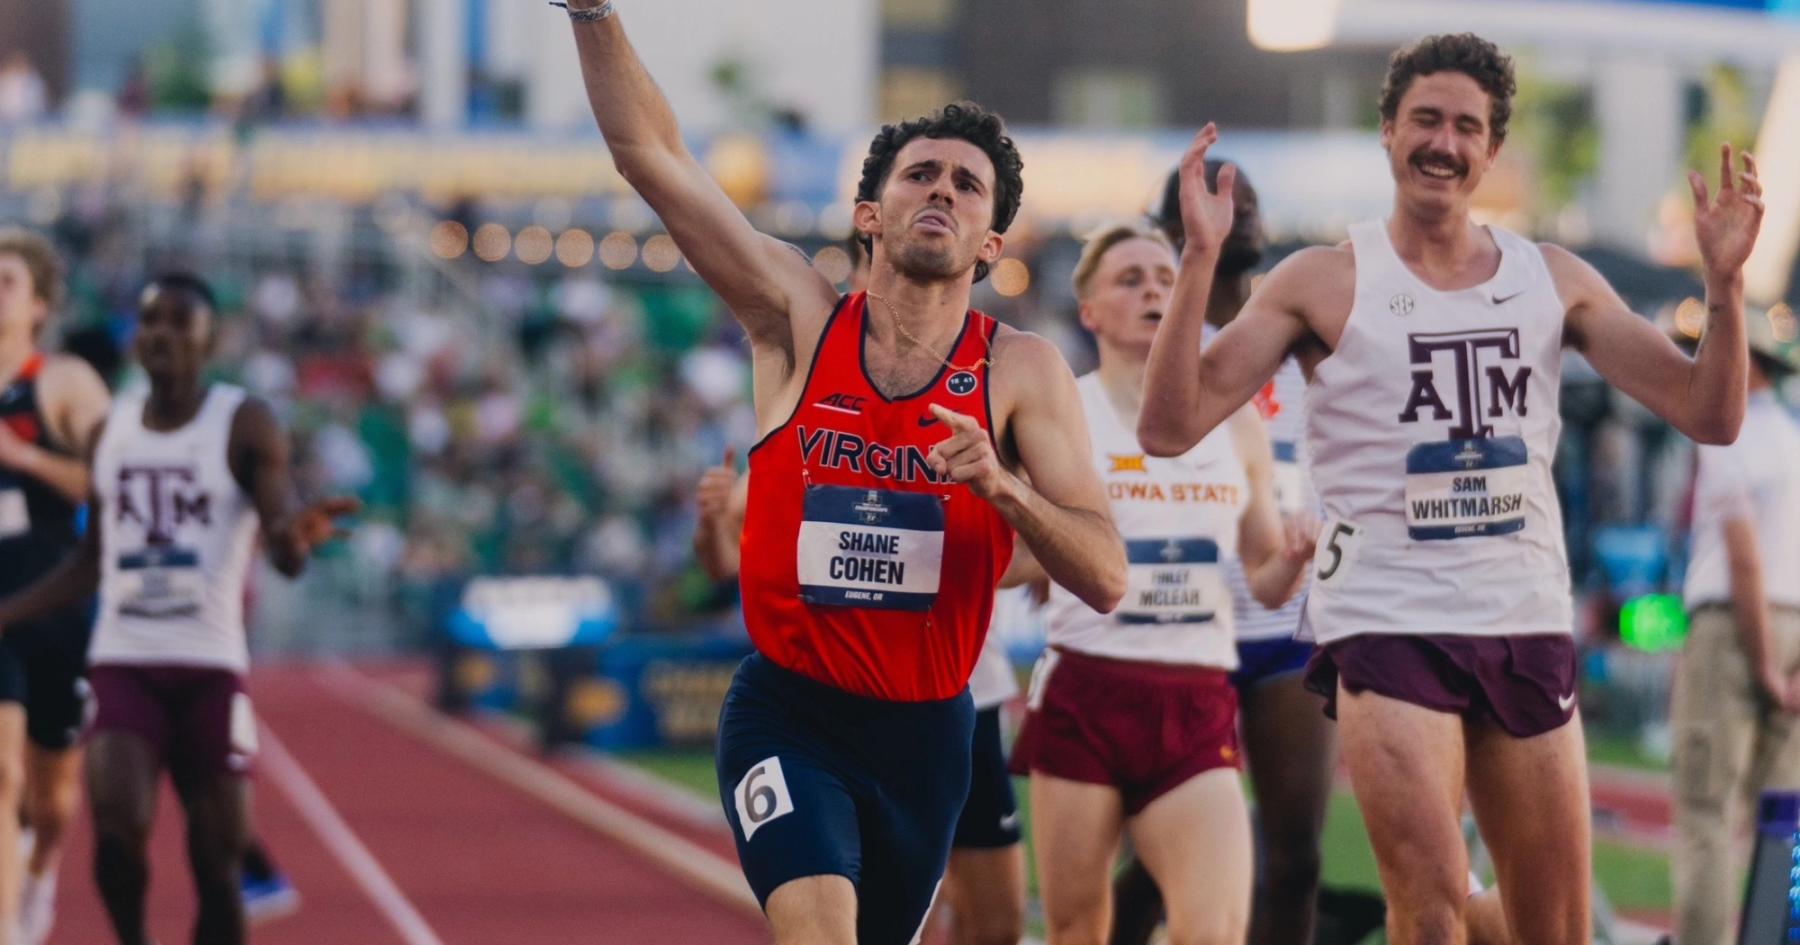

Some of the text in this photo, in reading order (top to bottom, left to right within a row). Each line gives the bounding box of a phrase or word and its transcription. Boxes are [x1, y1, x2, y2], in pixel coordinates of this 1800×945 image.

[818, 392, 867, 412] ACC
[797, 425, 958, 485] VIRGIN
[1452, 476, 1487, 493] SAM
[1412, 493, 1522, 520] WHITMARSH
[838, 531, 900, 554] SHANE
[1317, 522, 1355, 580] 5
[829, 556, 905, 585] COHEN
[744, 766, 777, 823] 6
